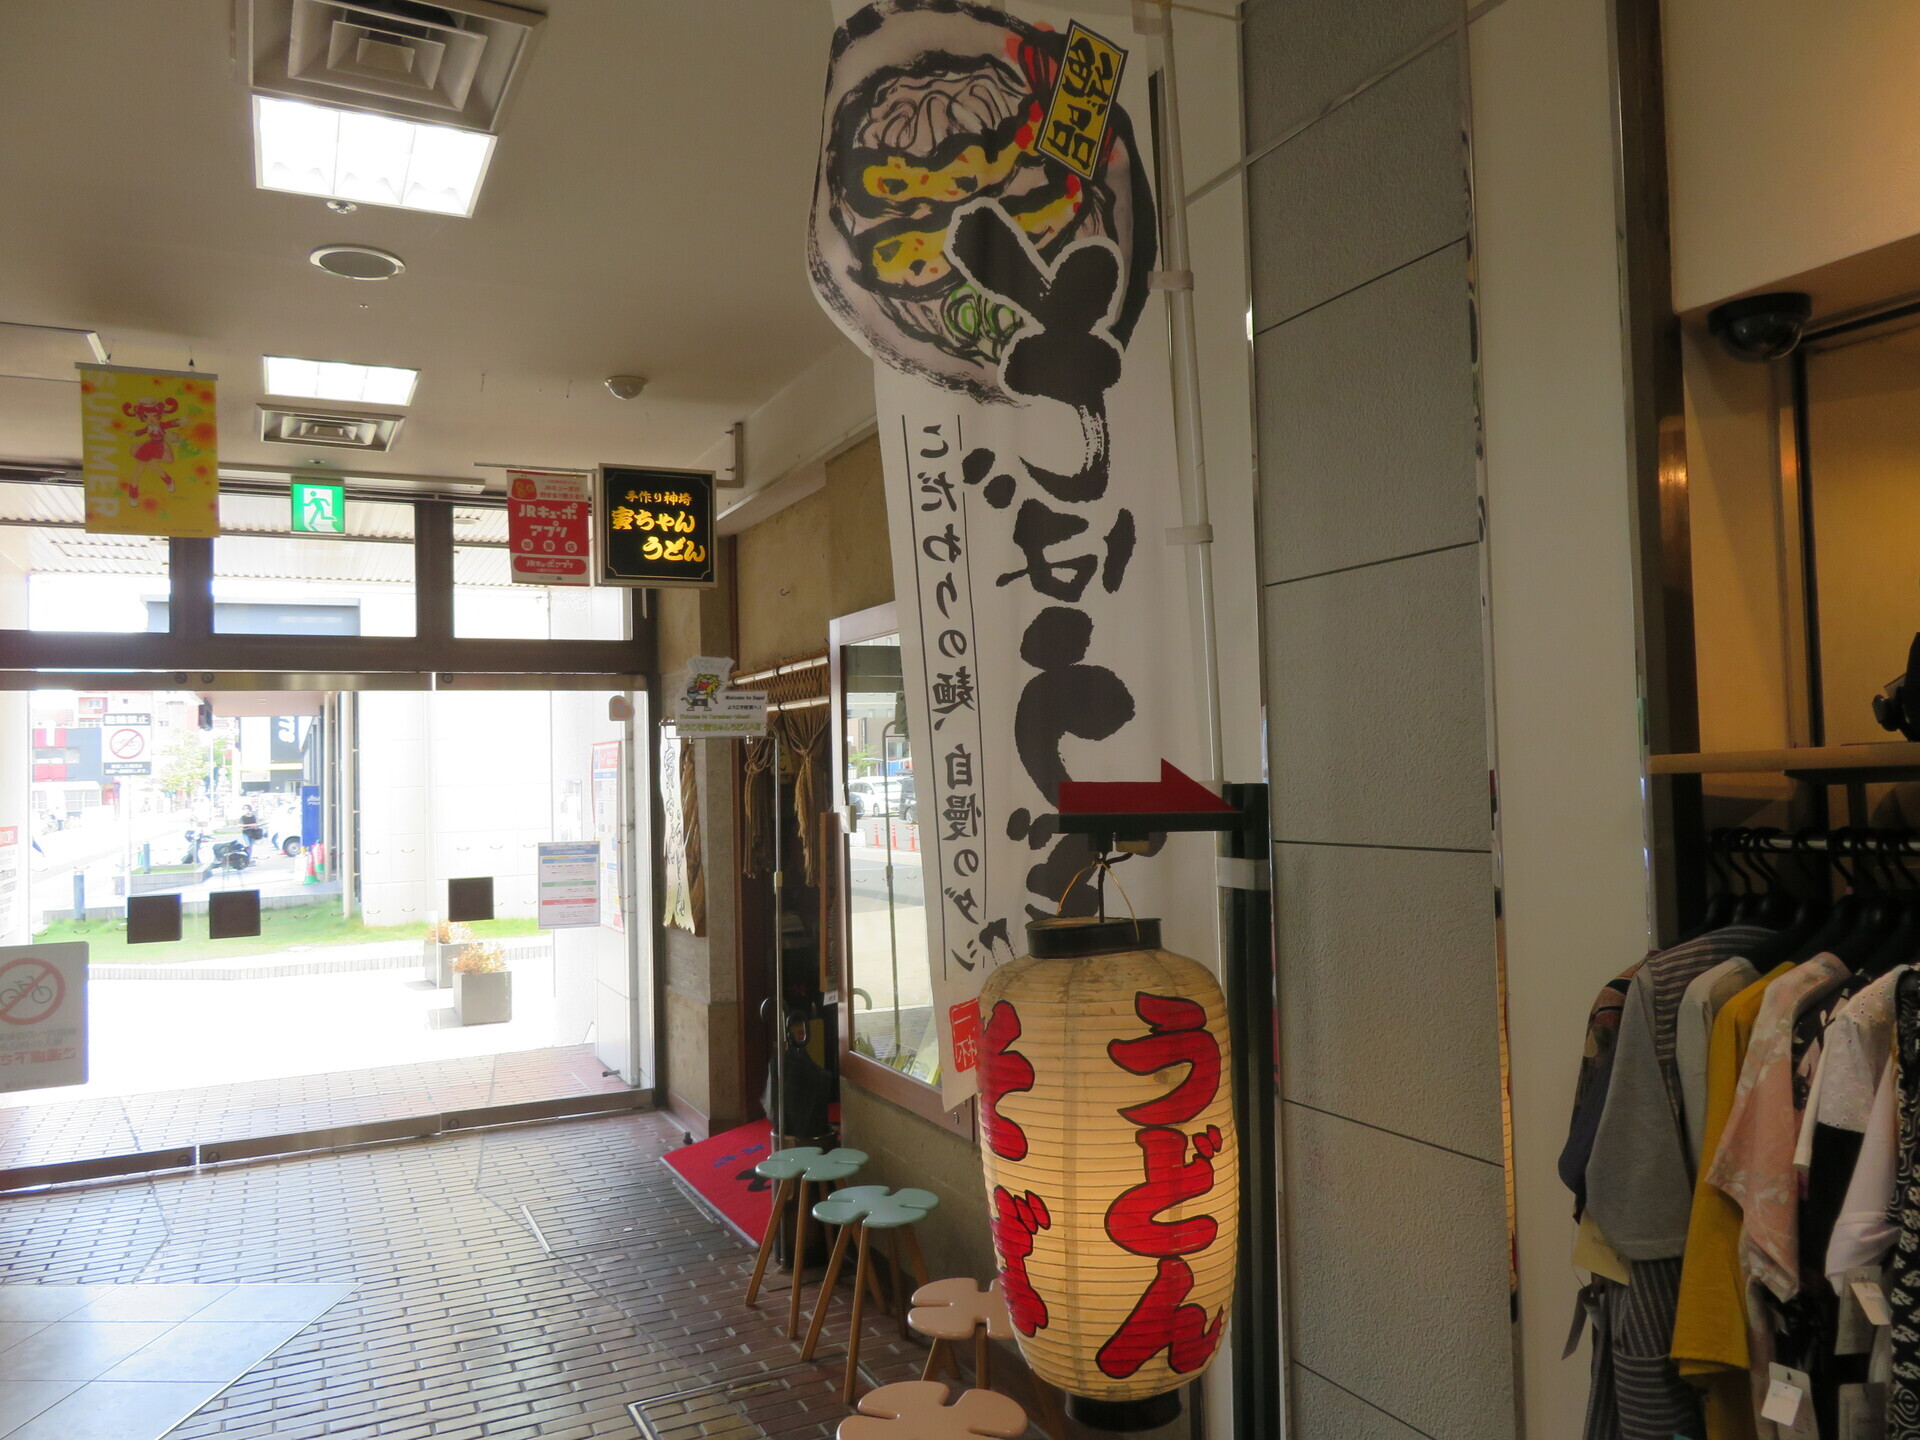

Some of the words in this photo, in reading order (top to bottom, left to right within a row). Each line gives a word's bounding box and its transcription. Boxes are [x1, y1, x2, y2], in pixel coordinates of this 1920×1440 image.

[85, 370, 121, 519] SUMMER
[624, 490, 693, 506] 手作り神埼
[518, 503, 578, 520] JRキューポ
[529, 521, 568, 538] アプリ
[642, 536, 706, 563] うどん
[1095, 990, 1223, 1379] うどん
